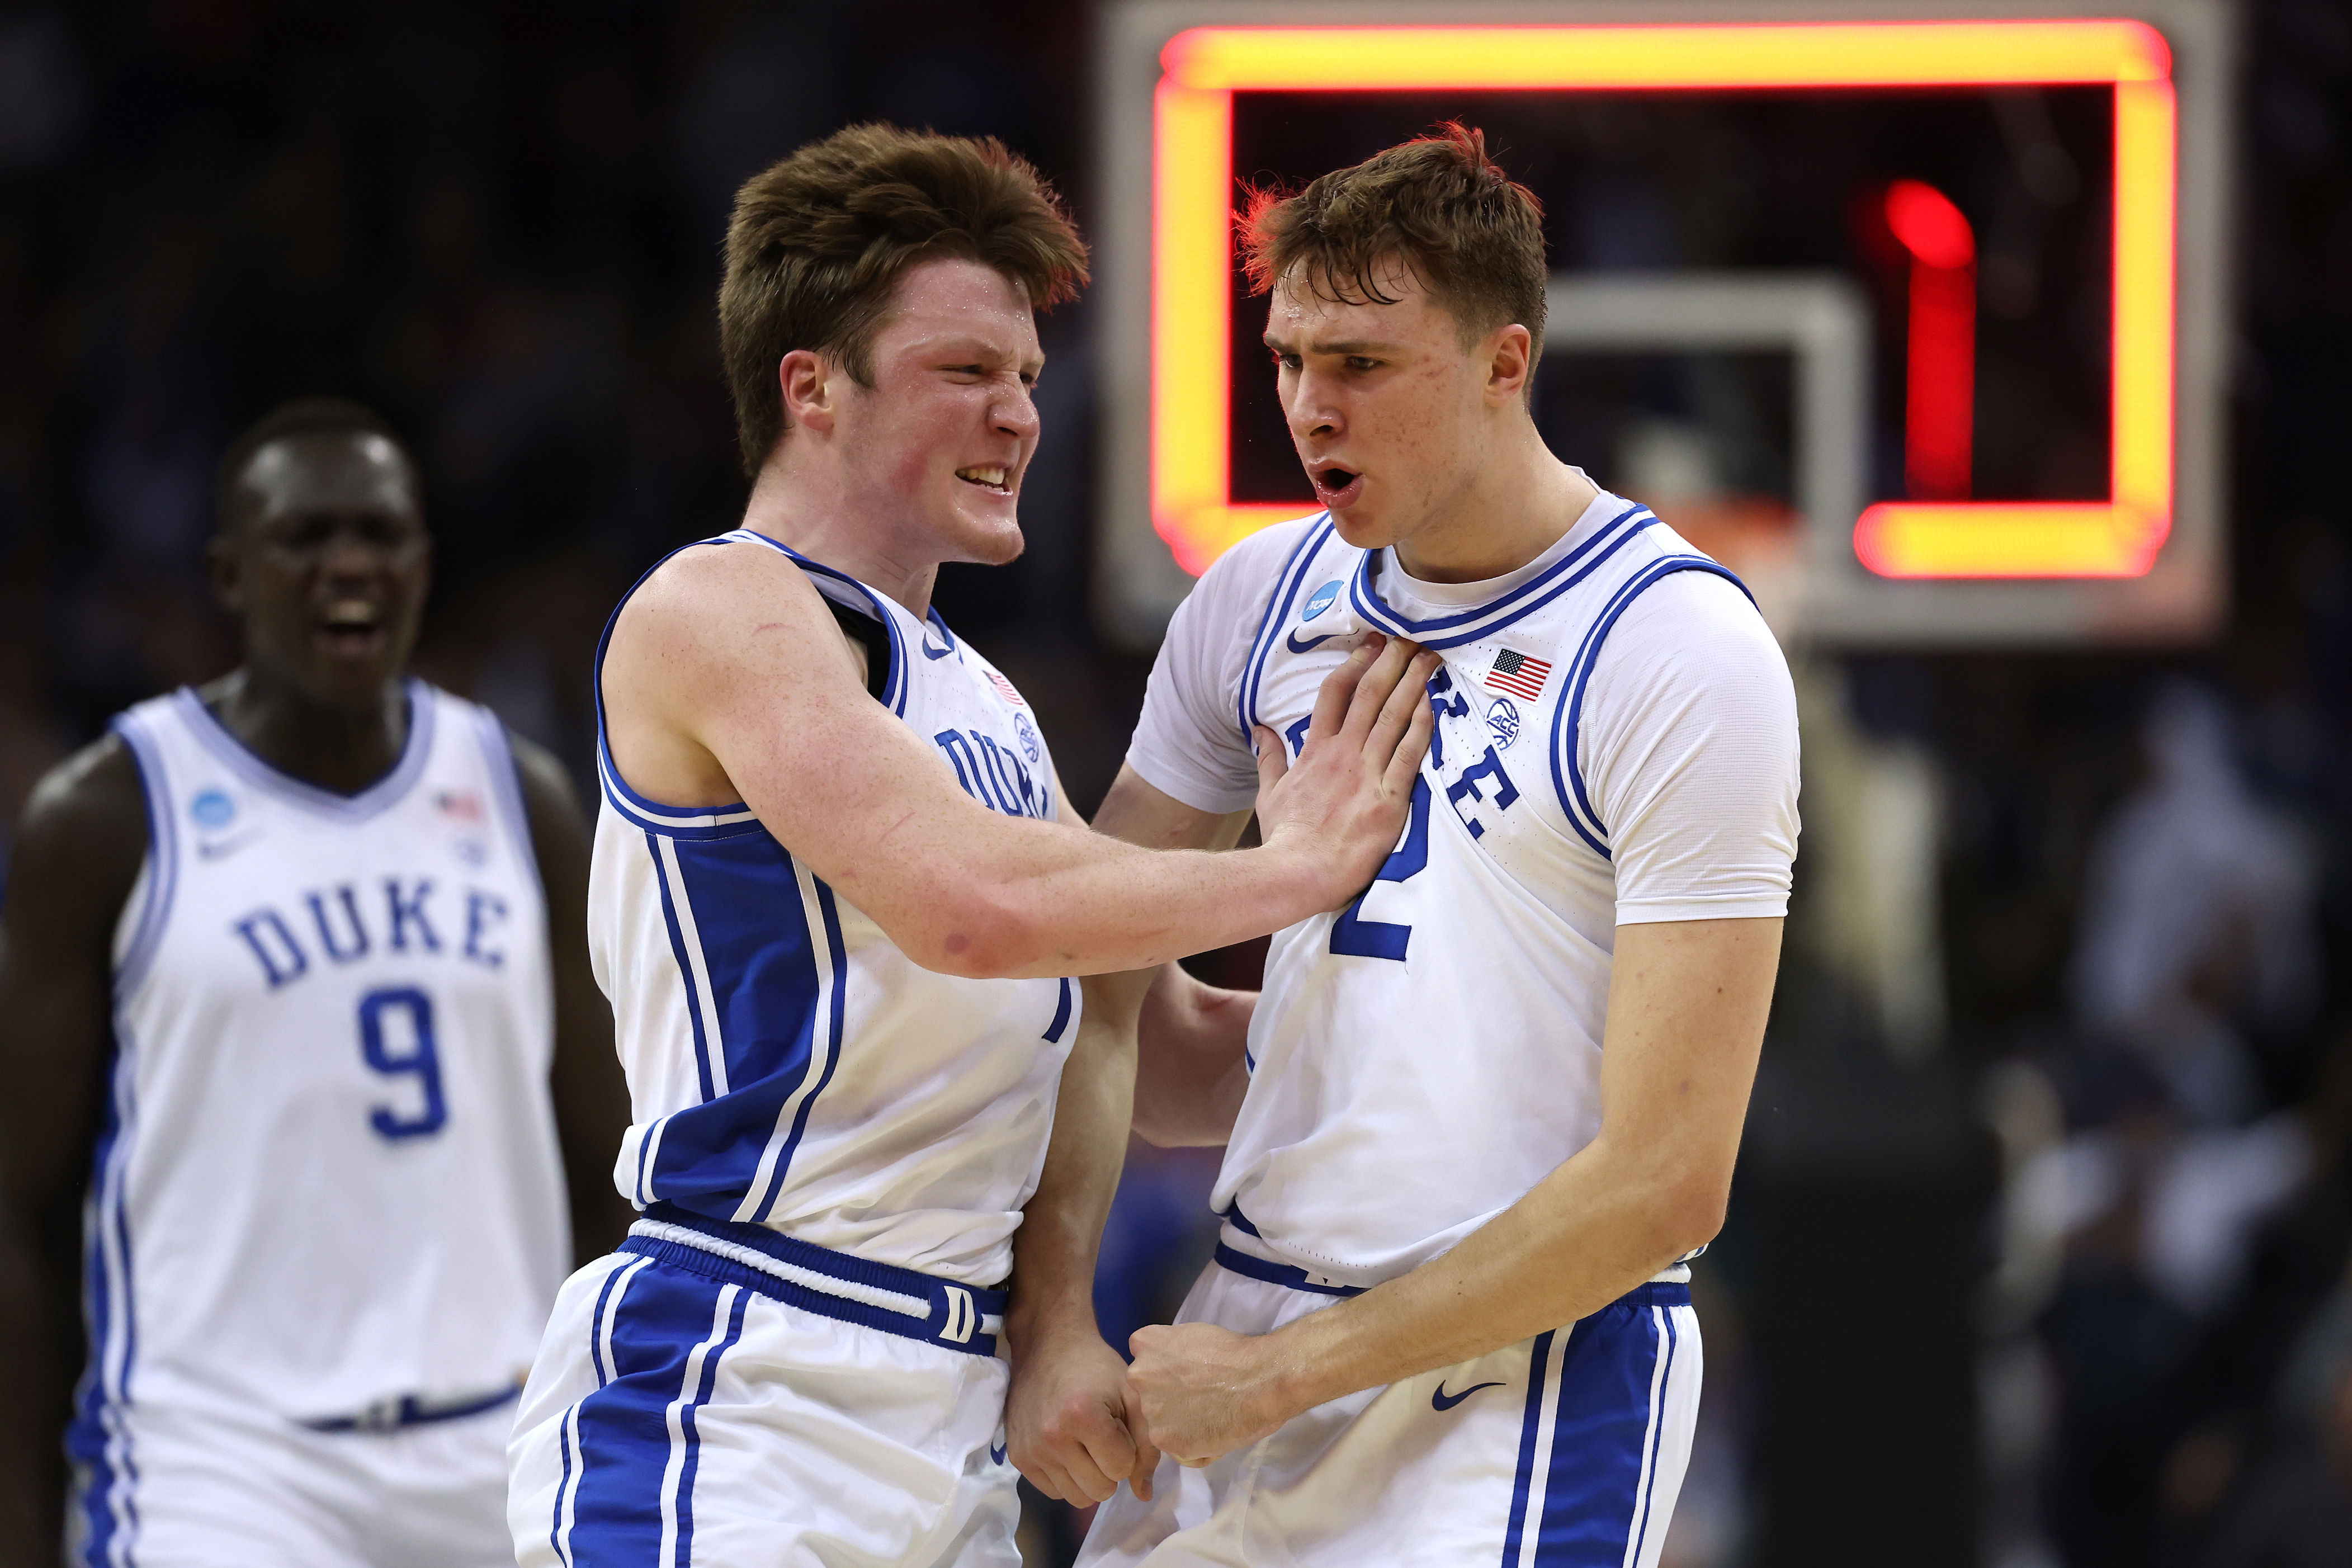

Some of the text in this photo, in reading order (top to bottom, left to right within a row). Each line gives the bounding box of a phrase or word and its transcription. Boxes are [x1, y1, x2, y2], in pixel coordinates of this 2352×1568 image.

[1490, 715, 1519, 735] ACC
[1329, 773, 1433, 962] 2
[233, 876, 508, 989] DUKE
[357, 985, 448, 1140] 9
[938, 1285, 975, 1344] D
